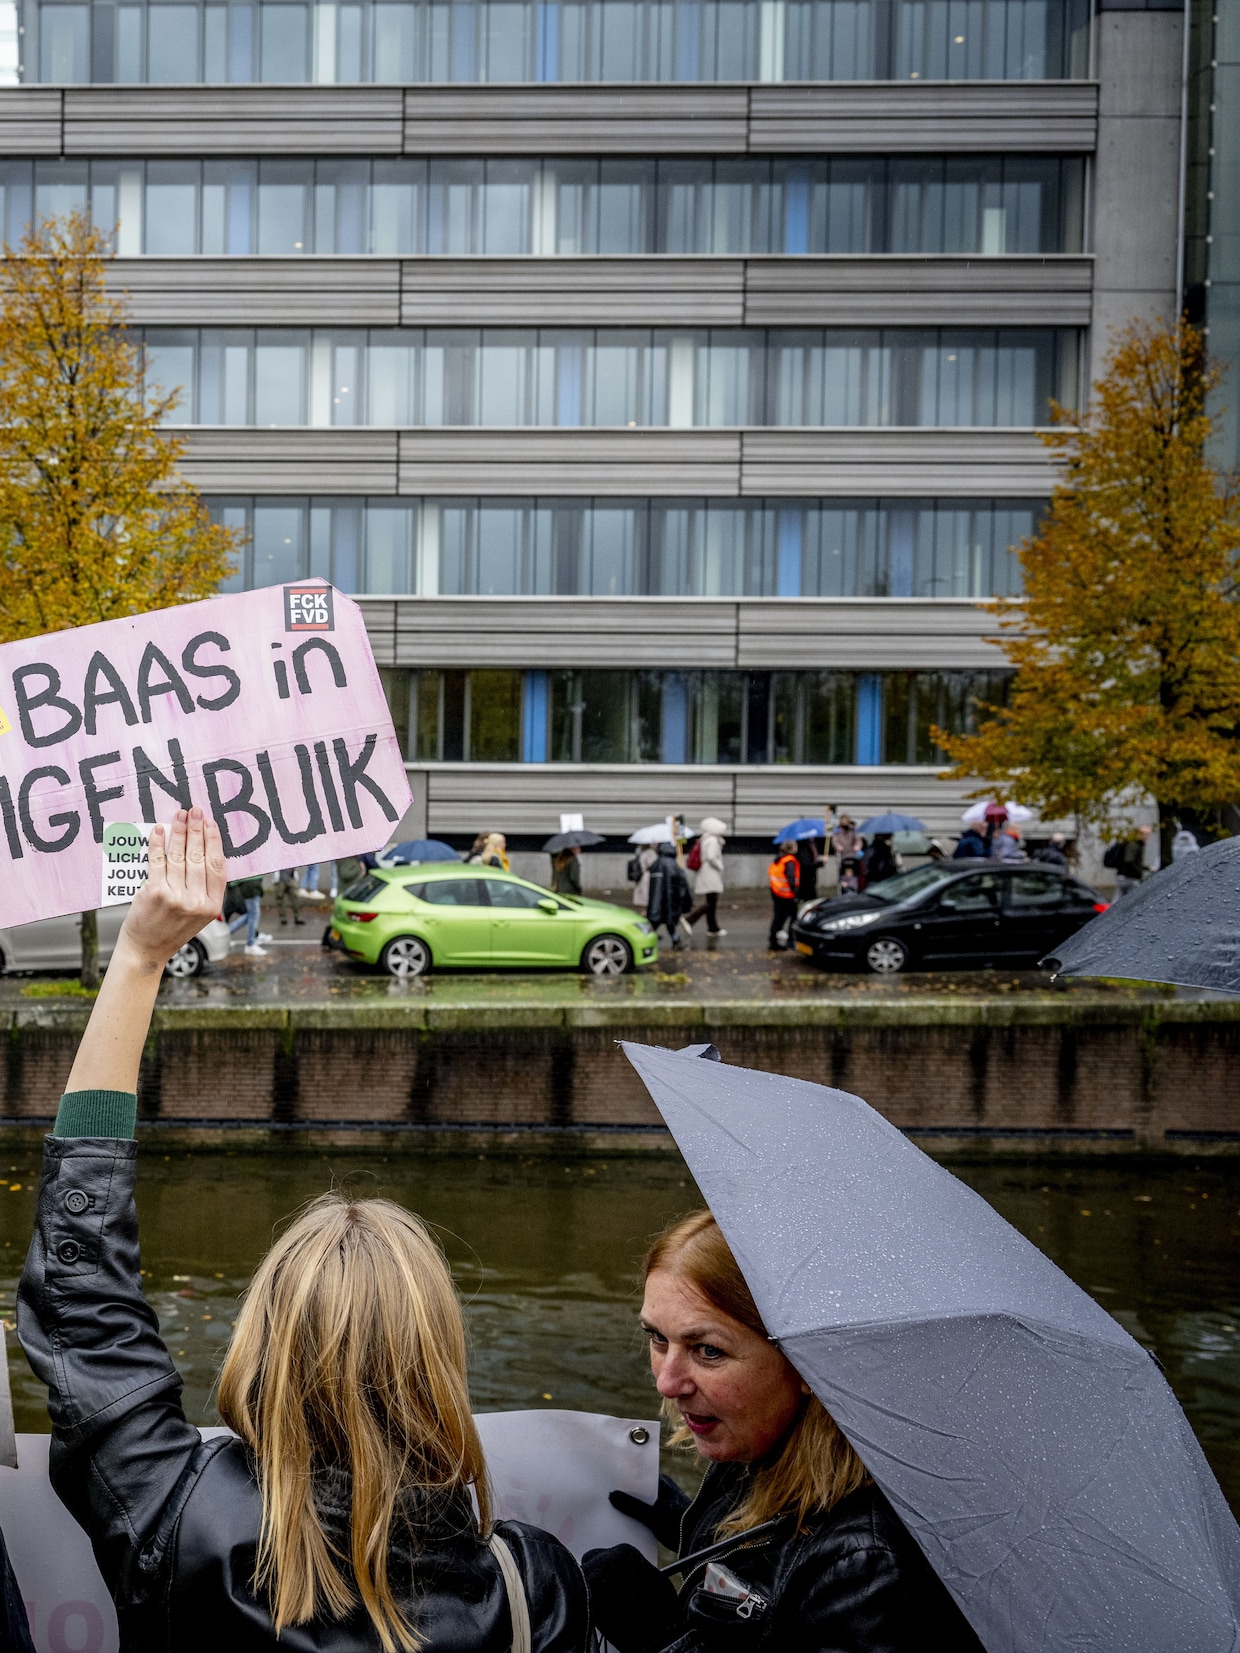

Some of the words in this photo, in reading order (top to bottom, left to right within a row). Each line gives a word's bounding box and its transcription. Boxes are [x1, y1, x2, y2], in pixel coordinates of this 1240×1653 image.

[290, 594, 328, 609] FCK
[290, 609, 329, 624] FVD
[12, 631, 241, 748] BAAS
[270, 637, 347, 699] in
[203, 733, 399, 858] BUIK
[108, 836, 149, 847] JOUW
[108, 853, 149, 863] LICHA
[107, 869, 149, 880] JOUW
